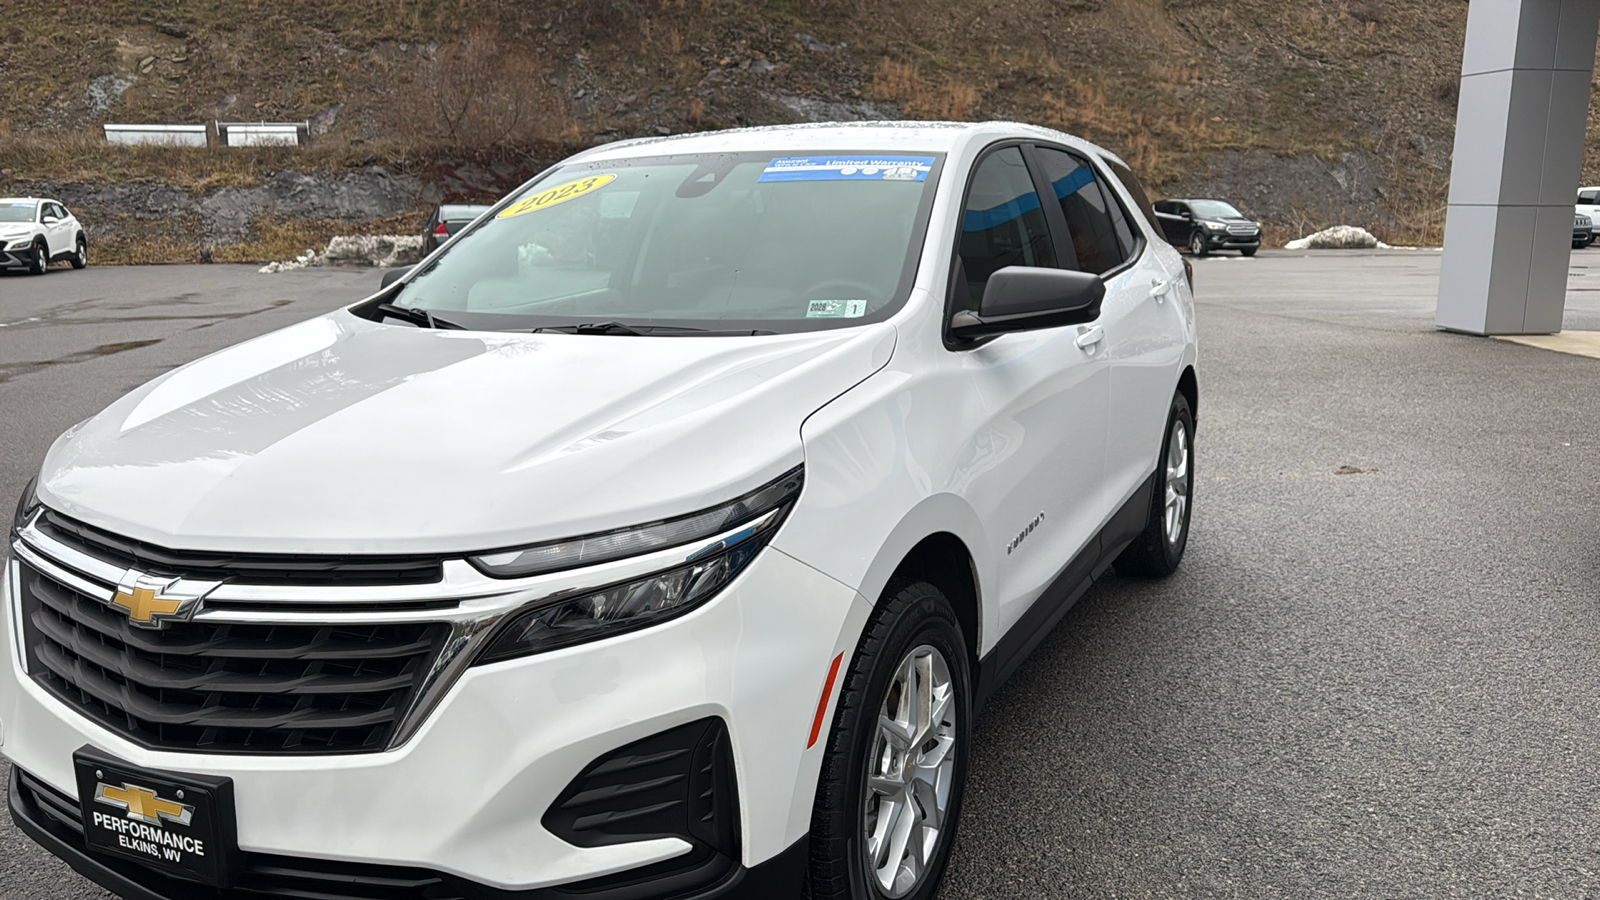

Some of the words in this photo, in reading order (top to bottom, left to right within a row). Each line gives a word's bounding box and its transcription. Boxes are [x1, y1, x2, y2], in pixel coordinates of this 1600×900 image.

[870, 159, 924, 167] Warranty
[514, 178, 598, 214] 2023
[852, 304, 858, 315] 1
[93, 811, 205, 856] PERFORMANCE
[118, 834, 162, 859] ELKINS,
[162, 847, 181, 863] WV
